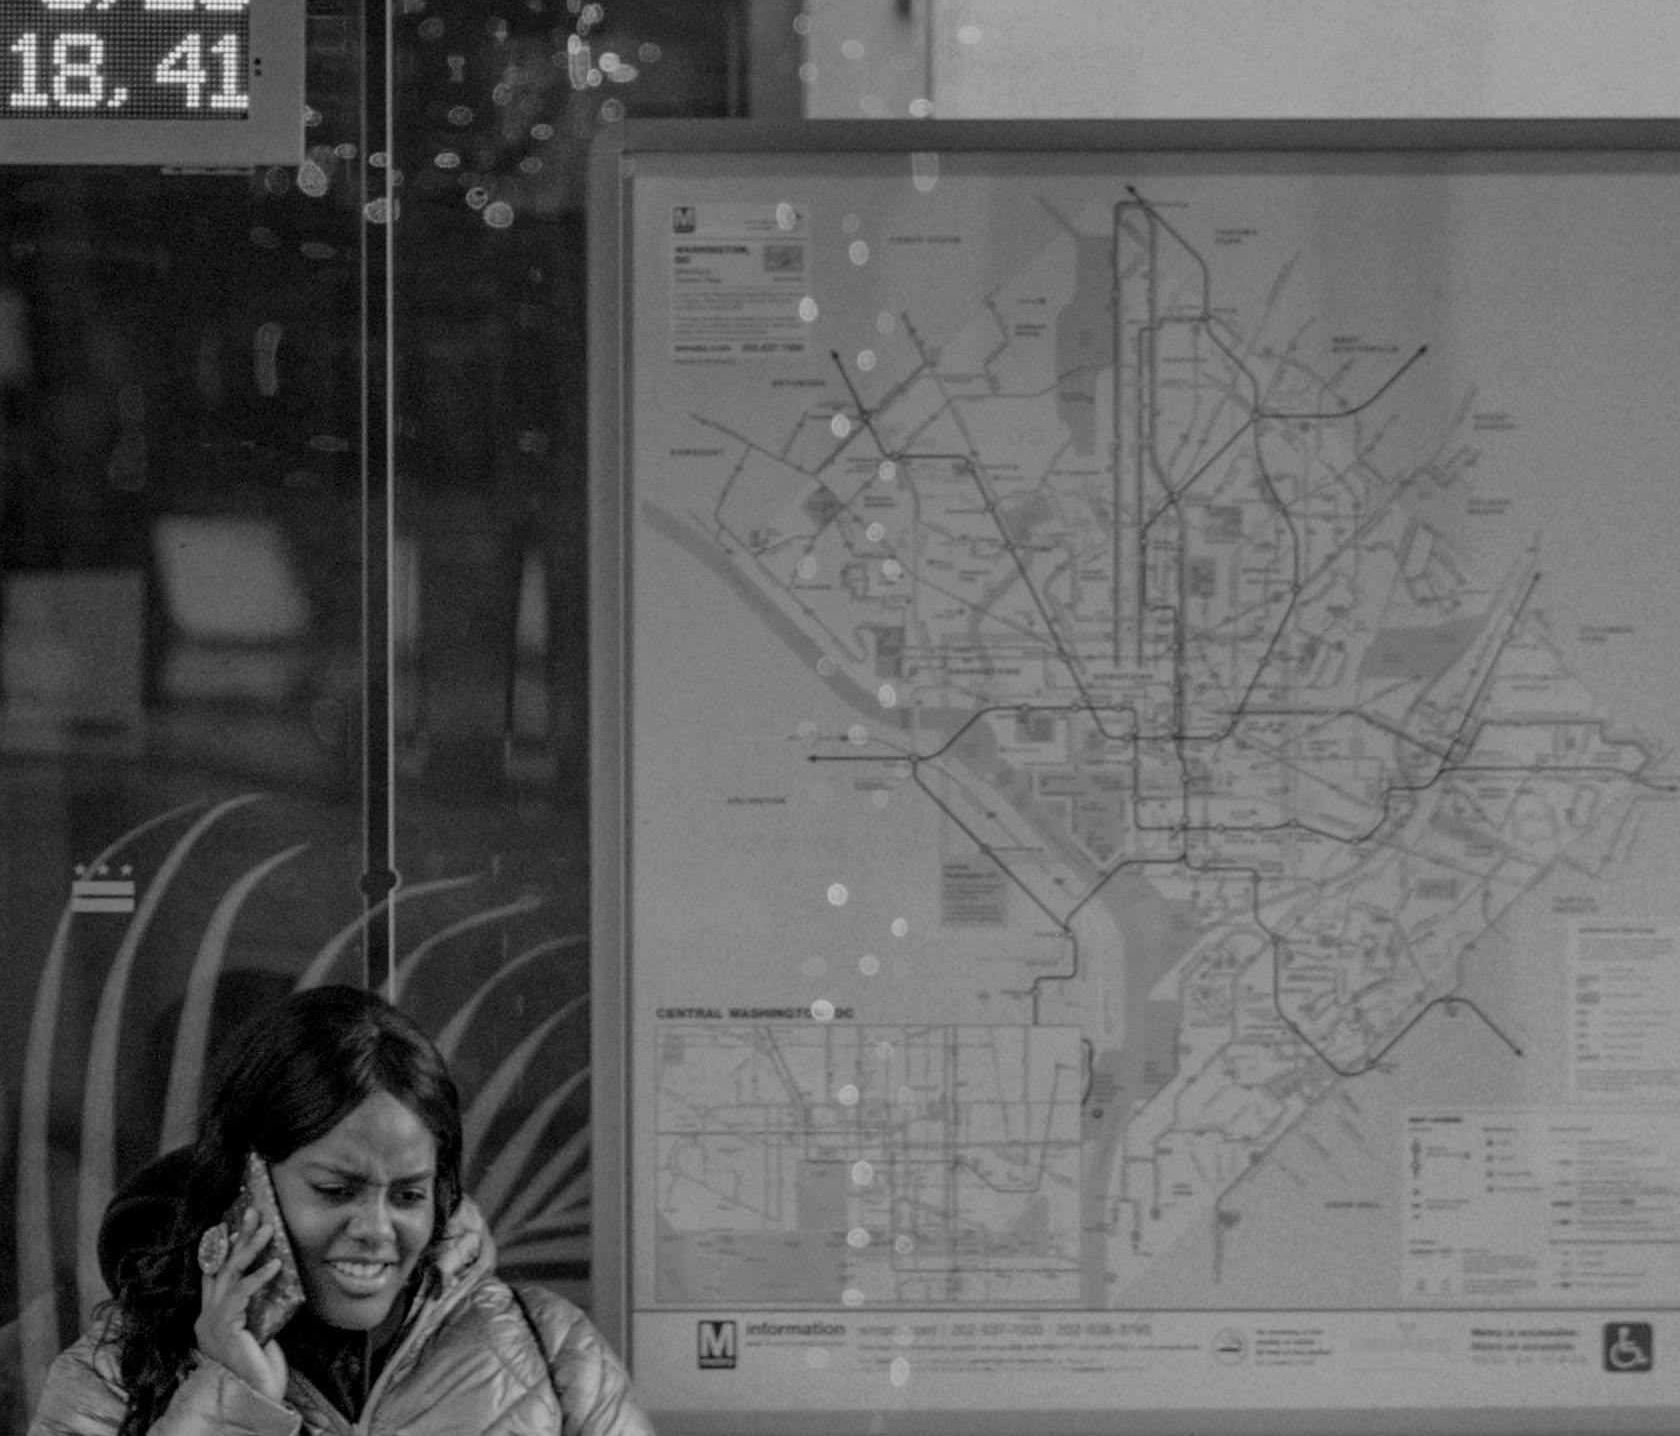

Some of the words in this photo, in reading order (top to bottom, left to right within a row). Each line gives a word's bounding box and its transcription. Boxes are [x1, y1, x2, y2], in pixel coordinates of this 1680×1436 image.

[8, 32, 129, 109] 18,
[155, 32, 250, 109] 41
[654, 1006, 725, 1020] CENTRAL
[727, 1006, 822, 1020] WASHINGTO
[745, 1321, 846, 1337] information
